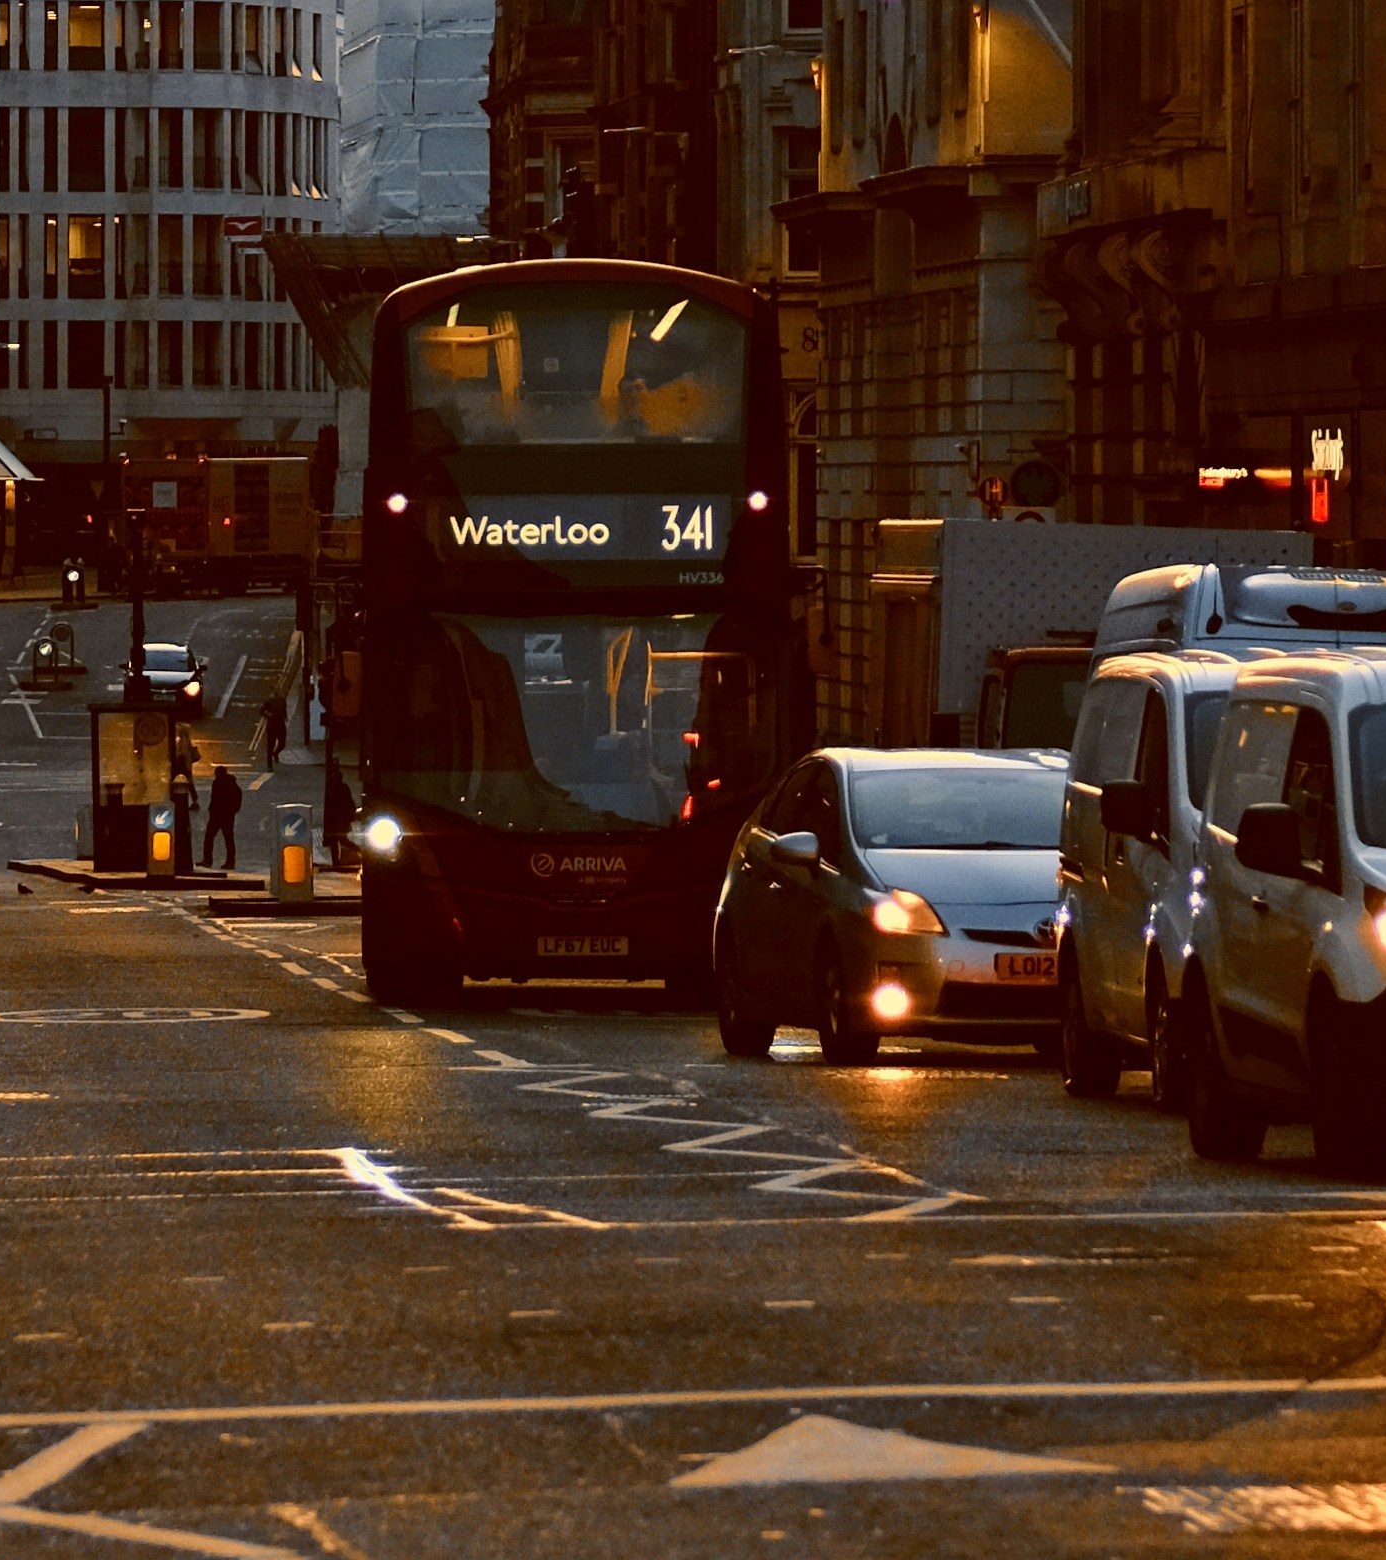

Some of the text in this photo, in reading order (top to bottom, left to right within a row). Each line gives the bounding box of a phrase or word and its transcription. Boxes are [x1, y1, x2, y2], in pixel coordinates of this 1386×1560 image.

[802, 326, 818, 352] 8
[450, 504, 713, 551] Waterloo 341
[679, 572, 725, 585] HV336
[558, 856, 627, 872] ARRIVA
[543, 937, 622, 954] LF67 EUC
